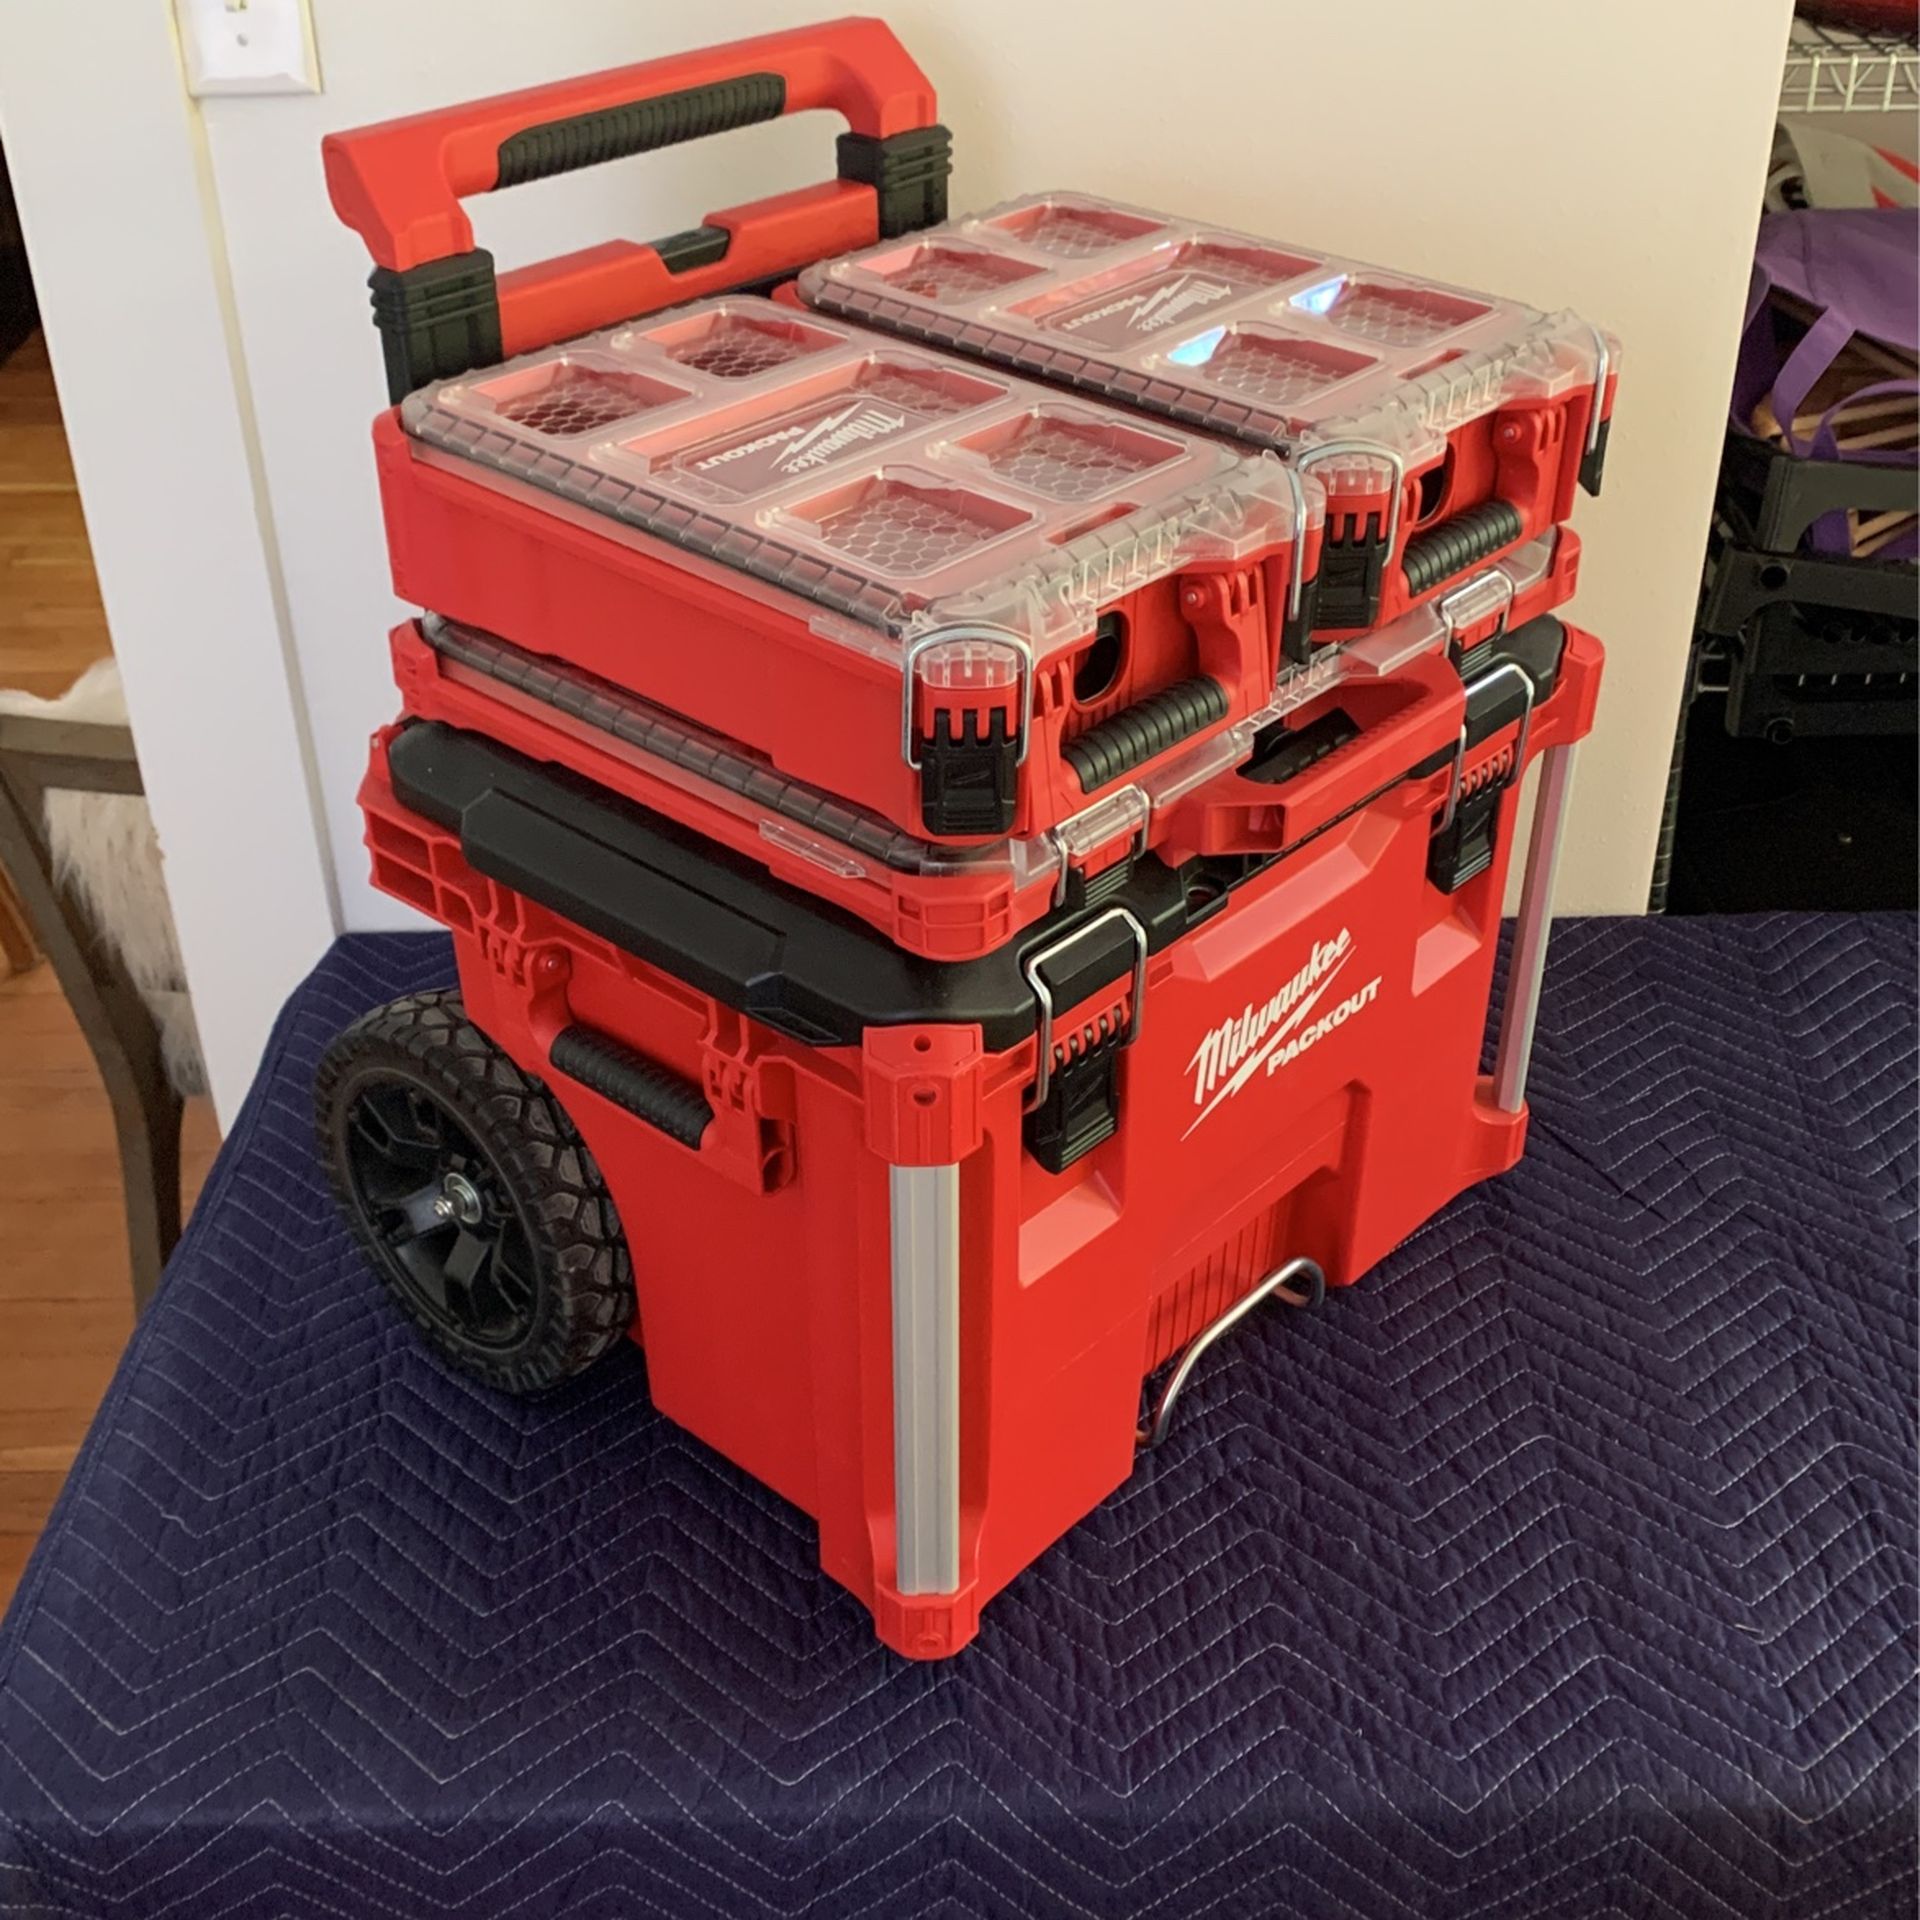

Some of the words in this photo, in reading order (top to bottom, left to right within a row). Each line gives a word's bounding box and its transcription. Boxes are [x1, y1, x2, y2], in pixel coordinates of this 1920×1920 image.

[696, 426, 806, 471] PACKOUT
[781, 409, 905, 473] Milwaukee
[1184, 927, 1352, 1105] Milwaukee
[1267, 975, 1382, 1077] PACKOUT
